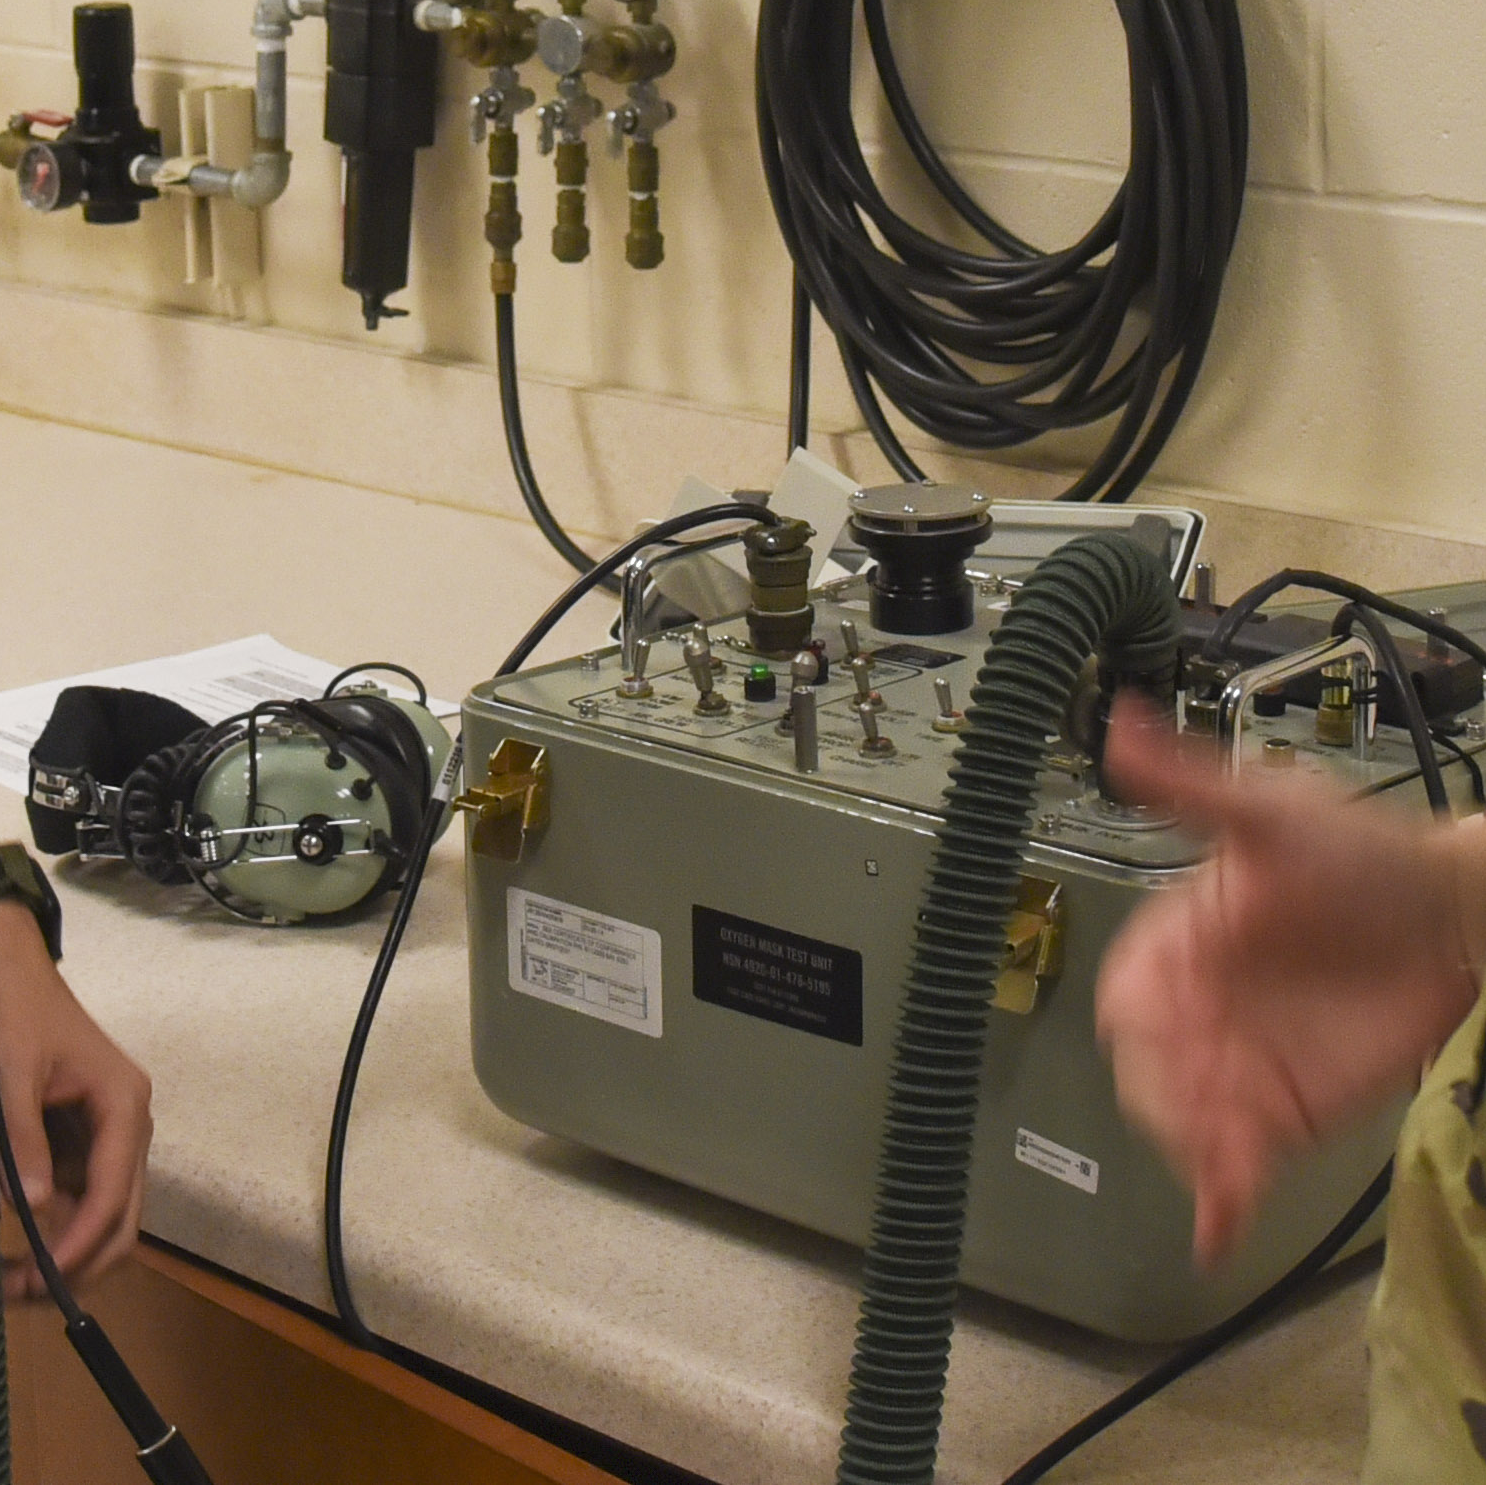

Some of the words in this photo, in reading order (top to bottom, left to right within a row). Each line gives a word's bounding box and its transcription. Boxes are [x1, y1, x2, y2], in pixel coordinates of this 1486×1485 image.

[720, 927, 757, 950] OXYGEN
[758, 937, 784, 959] MASK
[787, 945, 809, 966] TEST
[810, 952, 833, 972] UNIT
